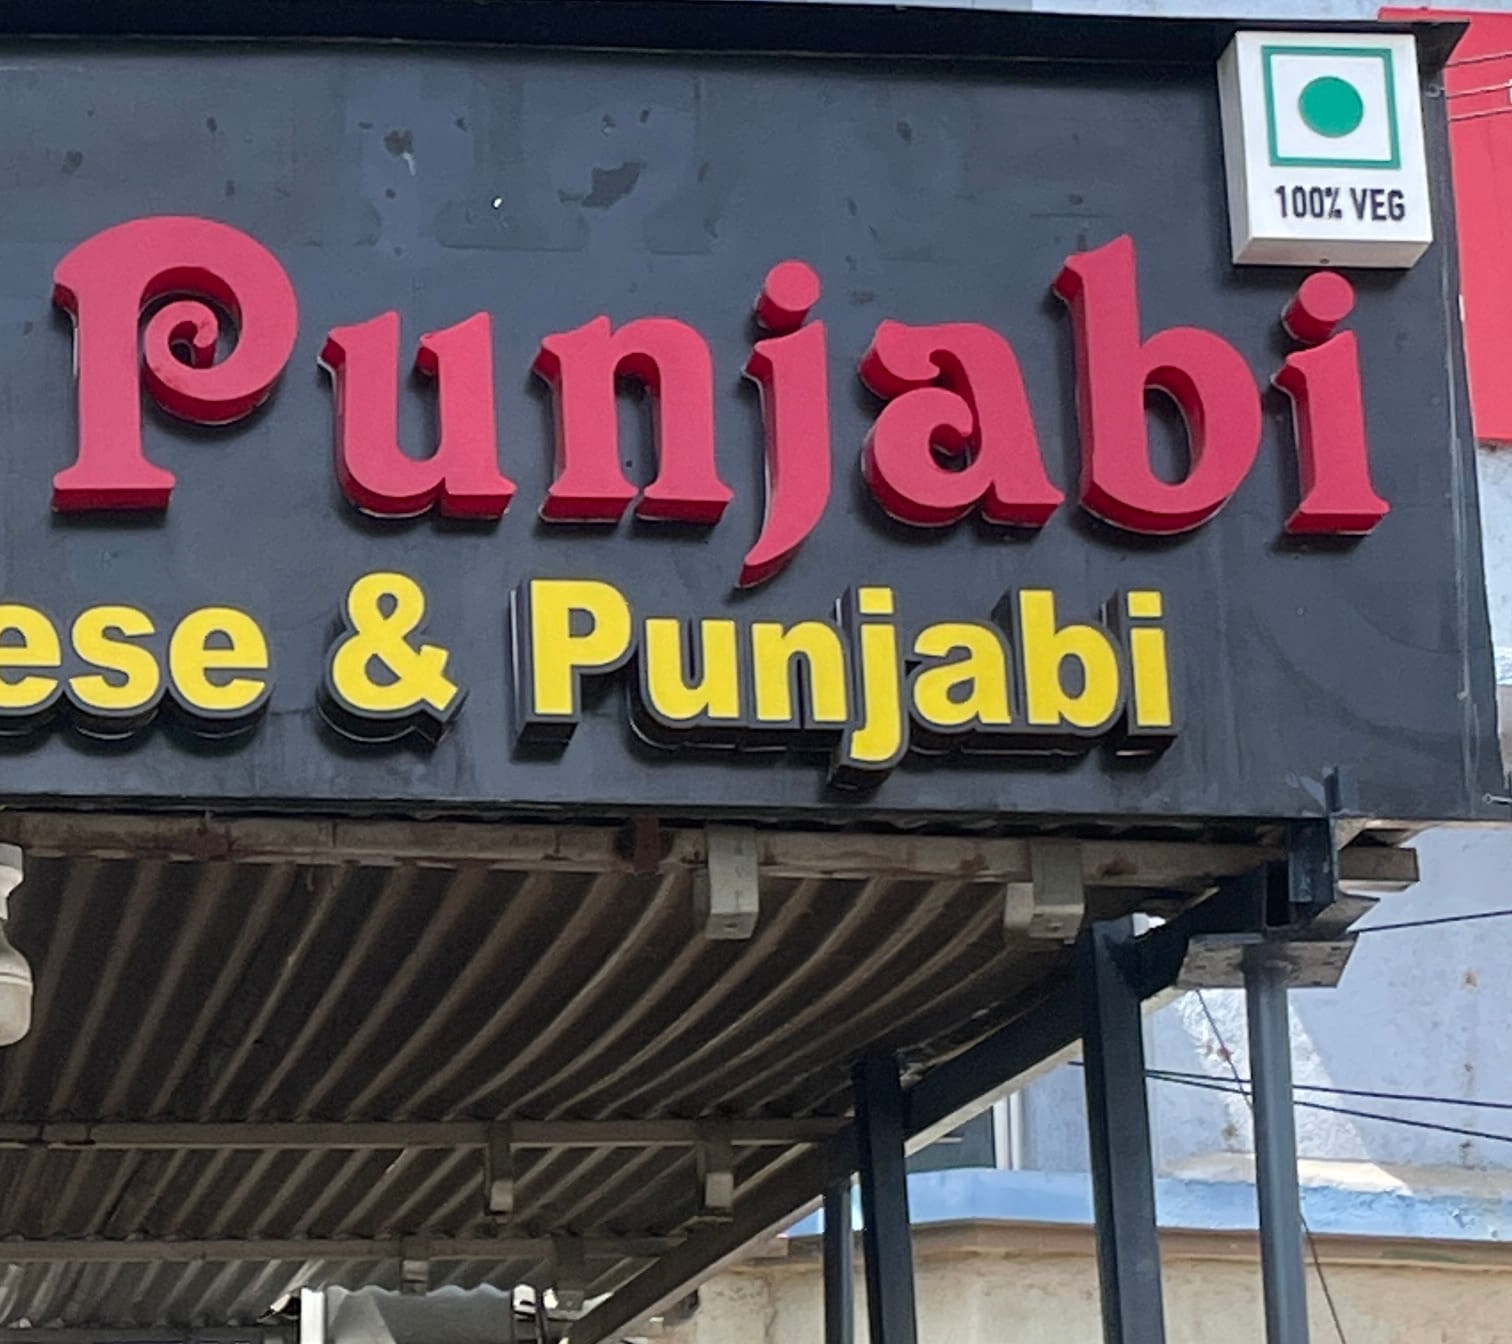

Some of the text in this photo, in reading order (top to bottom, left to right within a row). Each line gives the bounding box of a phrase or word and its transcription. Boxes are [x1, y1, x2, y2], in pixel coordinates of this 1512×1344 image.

[1275, 186, 1406, 222] 100% VEG
[52, 214, 1390, 588] Punjabi
[328, 572, 462, 731] &
[524, 578, 1176, 781] Punjabi
